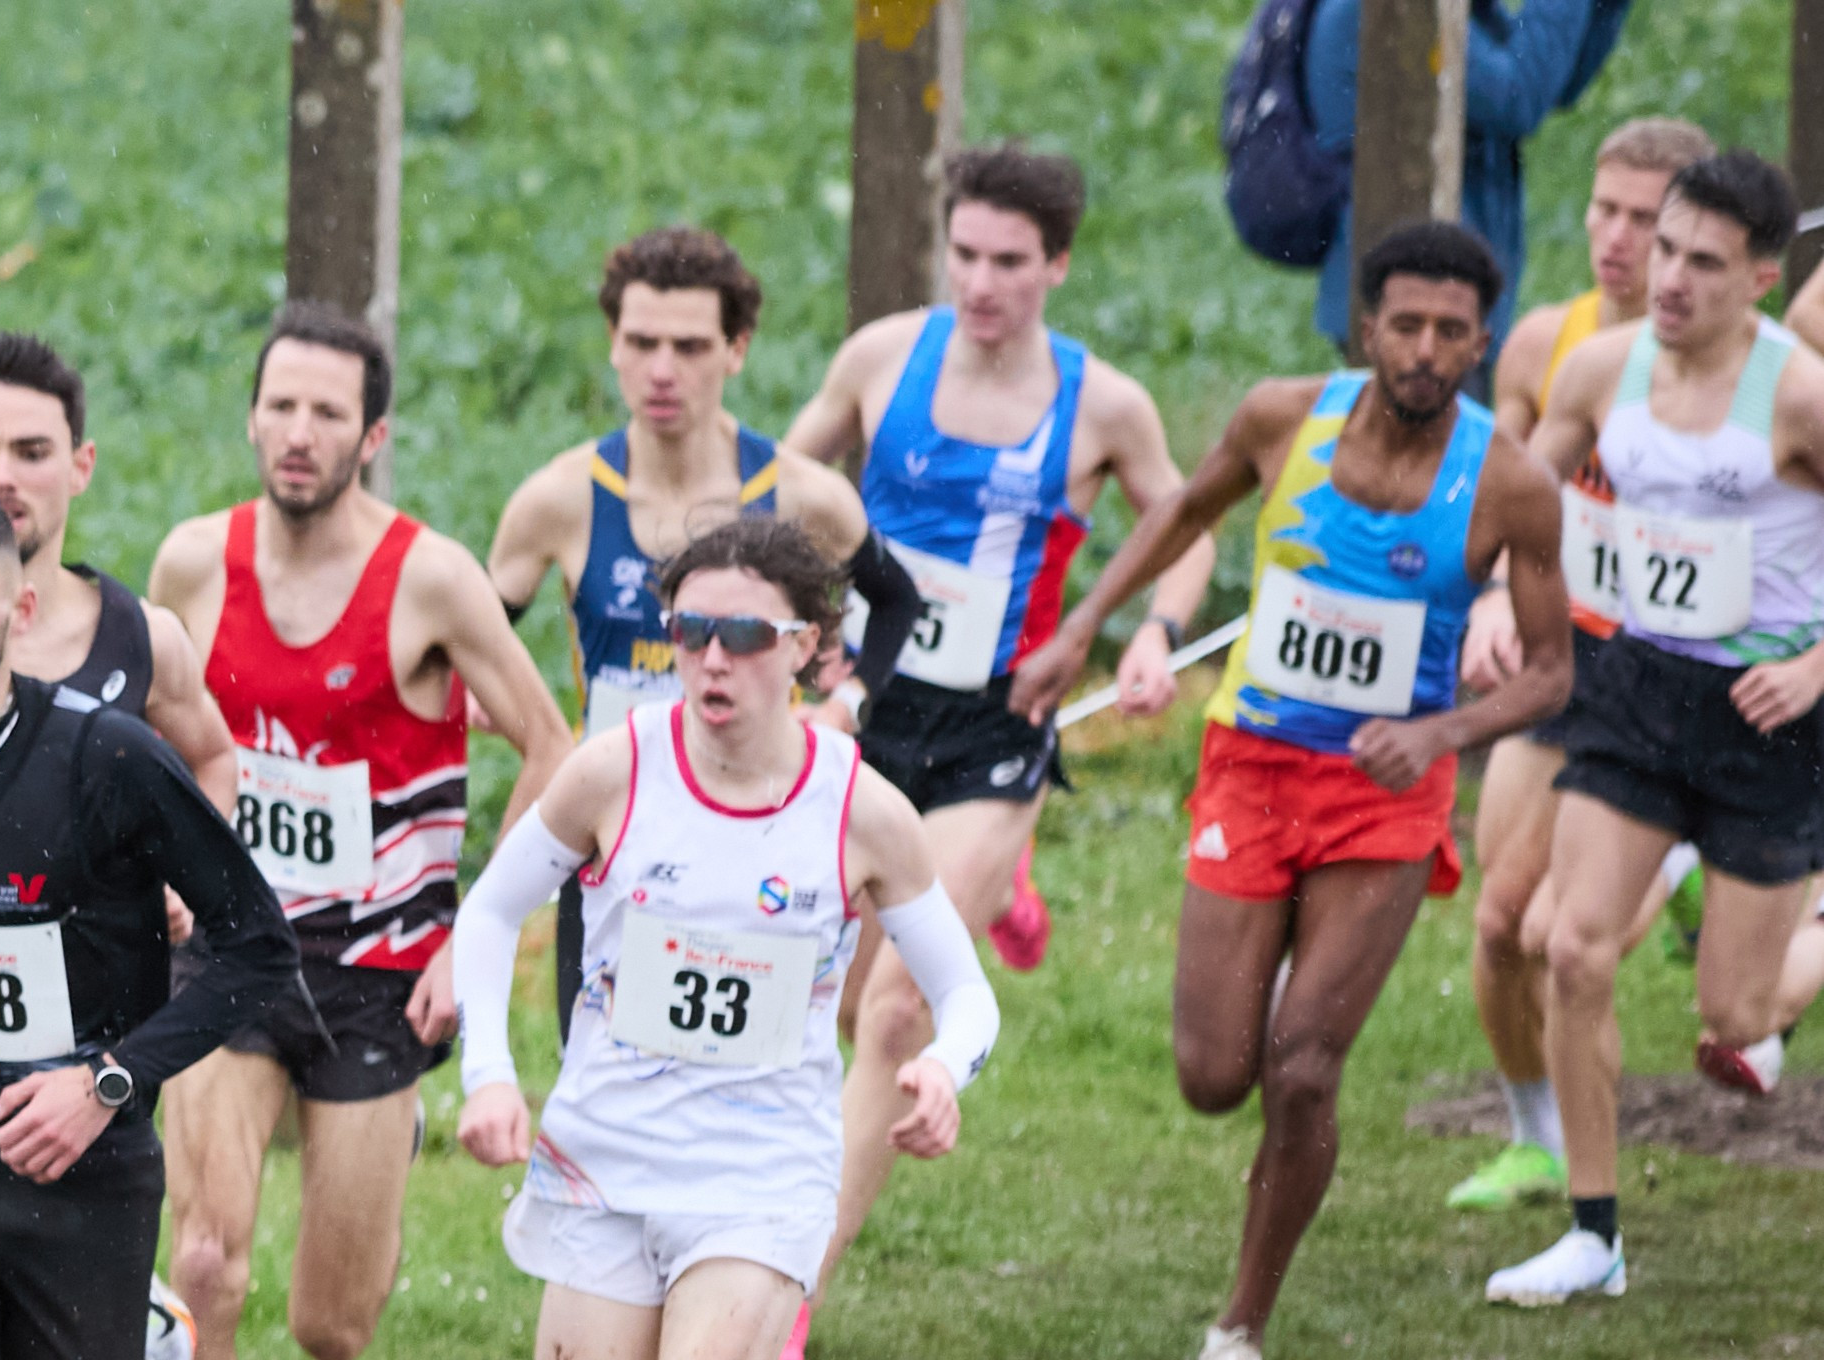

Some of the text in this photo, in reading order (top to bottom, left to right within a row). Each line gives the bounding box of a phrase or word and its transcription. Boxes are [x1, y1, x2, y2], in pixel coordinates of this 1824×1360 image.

[1647, 553, 1697, 610] 22
[1279, 619, 1382, 687] 809
[236, 794, 335, 865] 868
[669, 969, 751, 1037] 33
